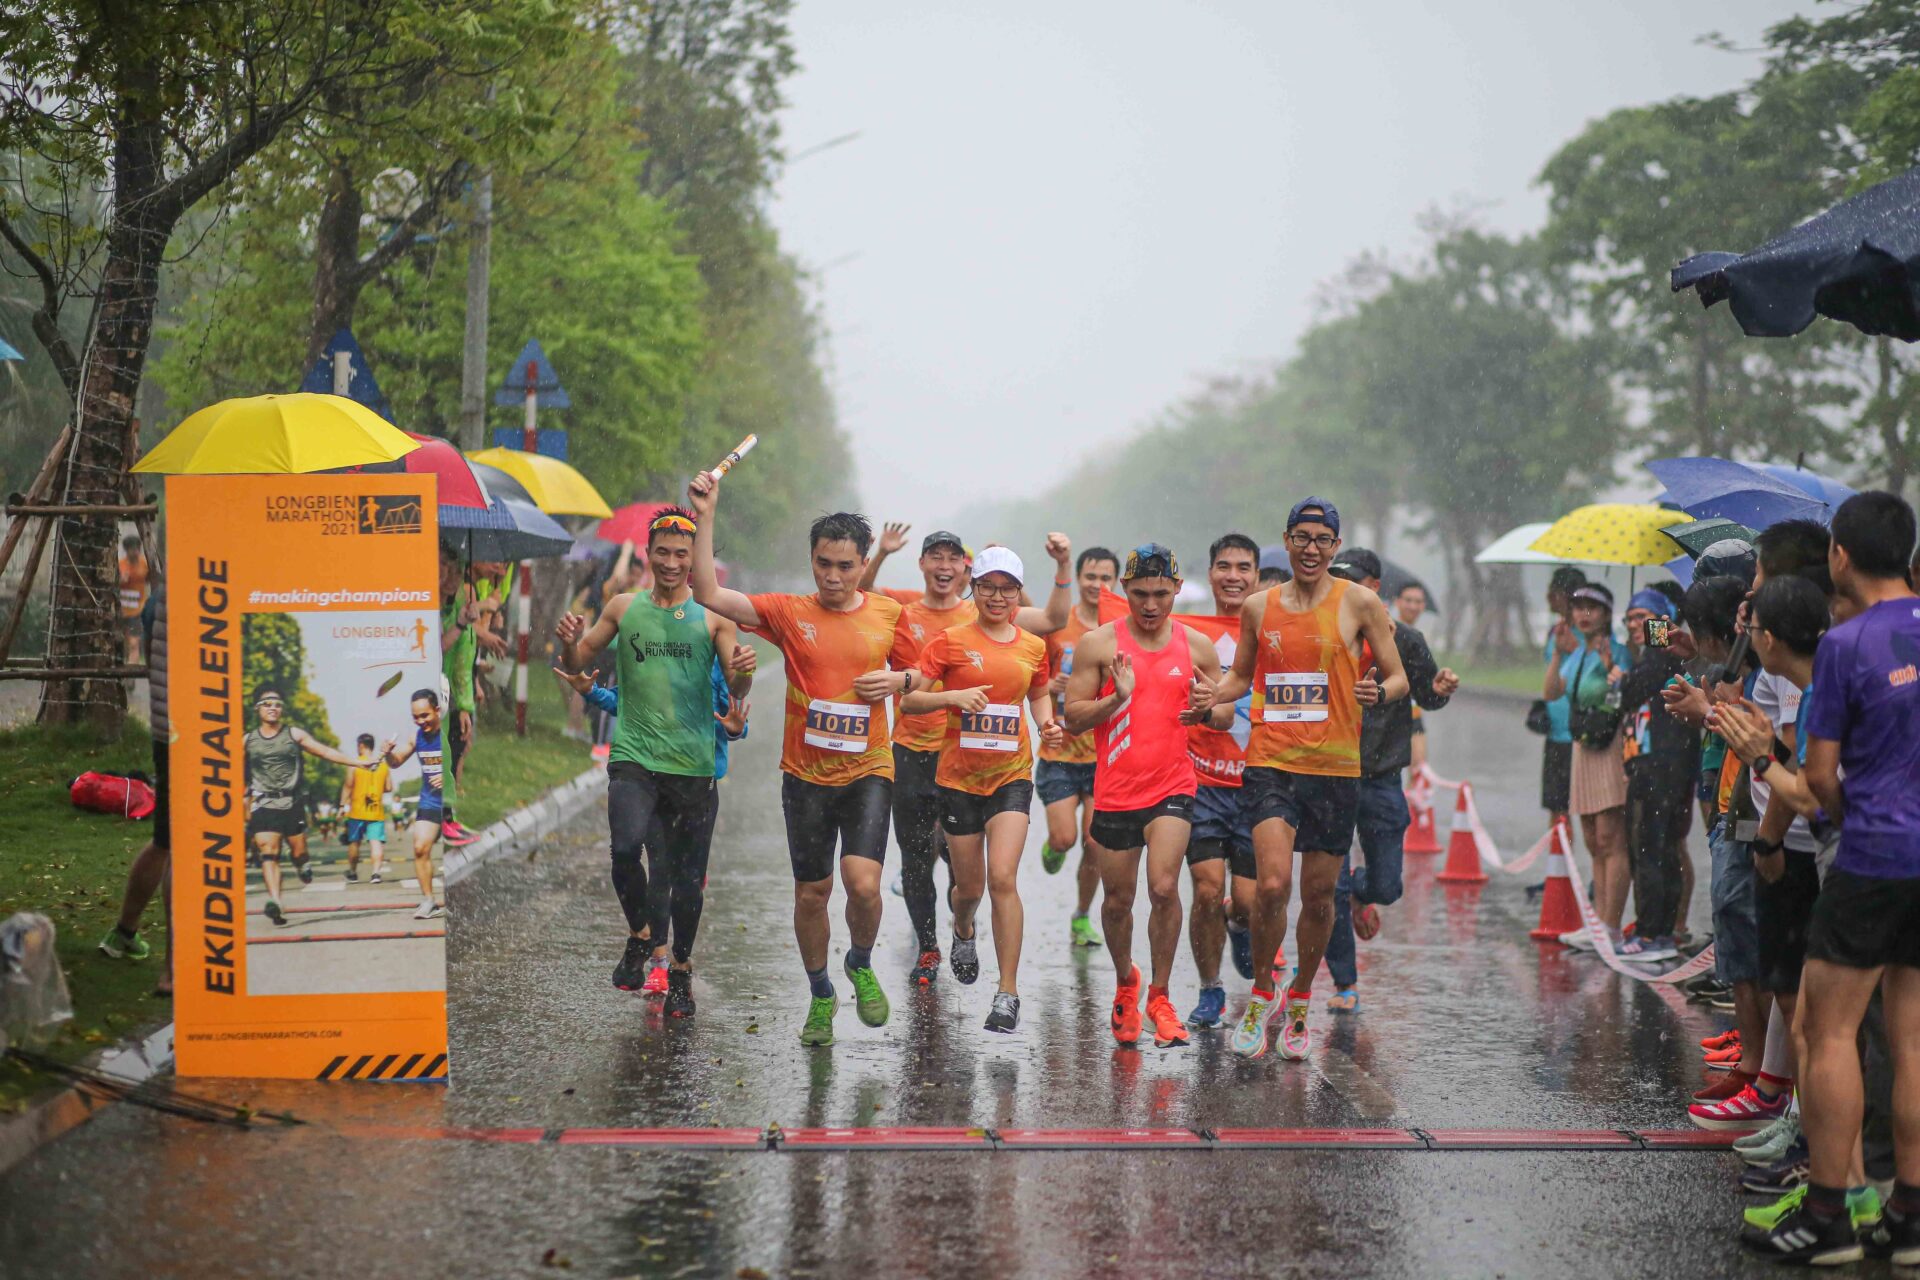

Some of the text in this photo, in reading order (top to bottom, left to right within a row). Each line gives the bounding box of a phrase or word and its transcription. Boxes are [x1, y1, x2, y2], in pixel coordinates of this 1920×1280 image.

[266, 496, 356, 509] LONGBIEN
[266, 510, 356, 522] MARATHON
[321, 523, 356, 535] 2021
[248, 588, 431, 606] #makingchampions
[332, 626, 406, 638] LONGBIEN
[645, 647, 692, 659] RUNNERS
[1271, 685, 1324, 703] 1012
[814, 712, 865, 735] 1015
[968, 715, 1016, 734] 1014
[198, 557, 235, 995] EKIDEN CHALLENGE
[187, 1030, 342, 1041] WWW.LONGBIENMARATHON.COM
